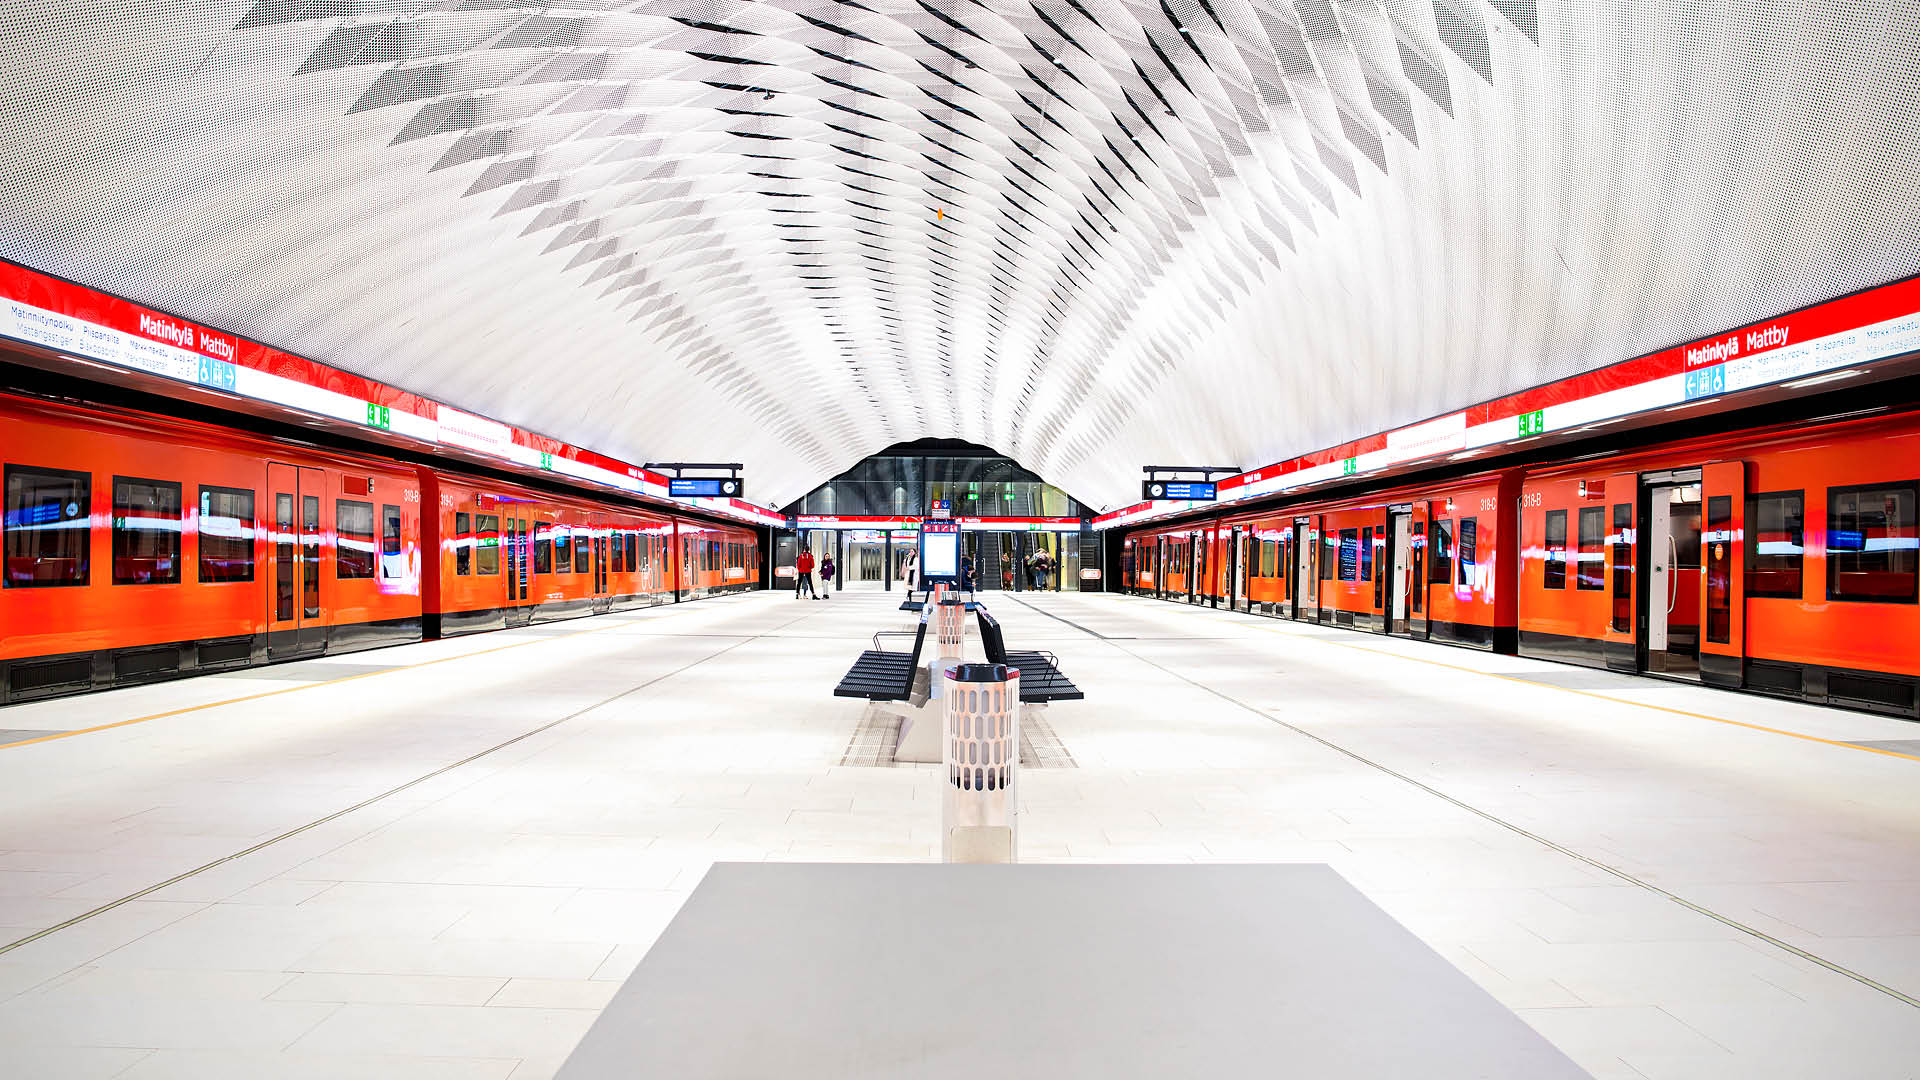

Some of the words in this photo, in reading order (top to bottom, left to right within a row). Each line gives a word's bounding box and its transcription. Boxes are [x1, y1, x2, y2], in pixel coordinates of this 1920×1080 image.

[139, 313, 194, 349] Matinkylä
[200, 332, 234, 361] Mattby
[1687, 337, 1739, 366] Matinkylä
[1746, 324, 1789, 351] Mattby
[403, 489, 419, 503] 319-B
[1523, 492, 1542, 506] 318-B
[1480, 497, 1496, 511] 318-C
